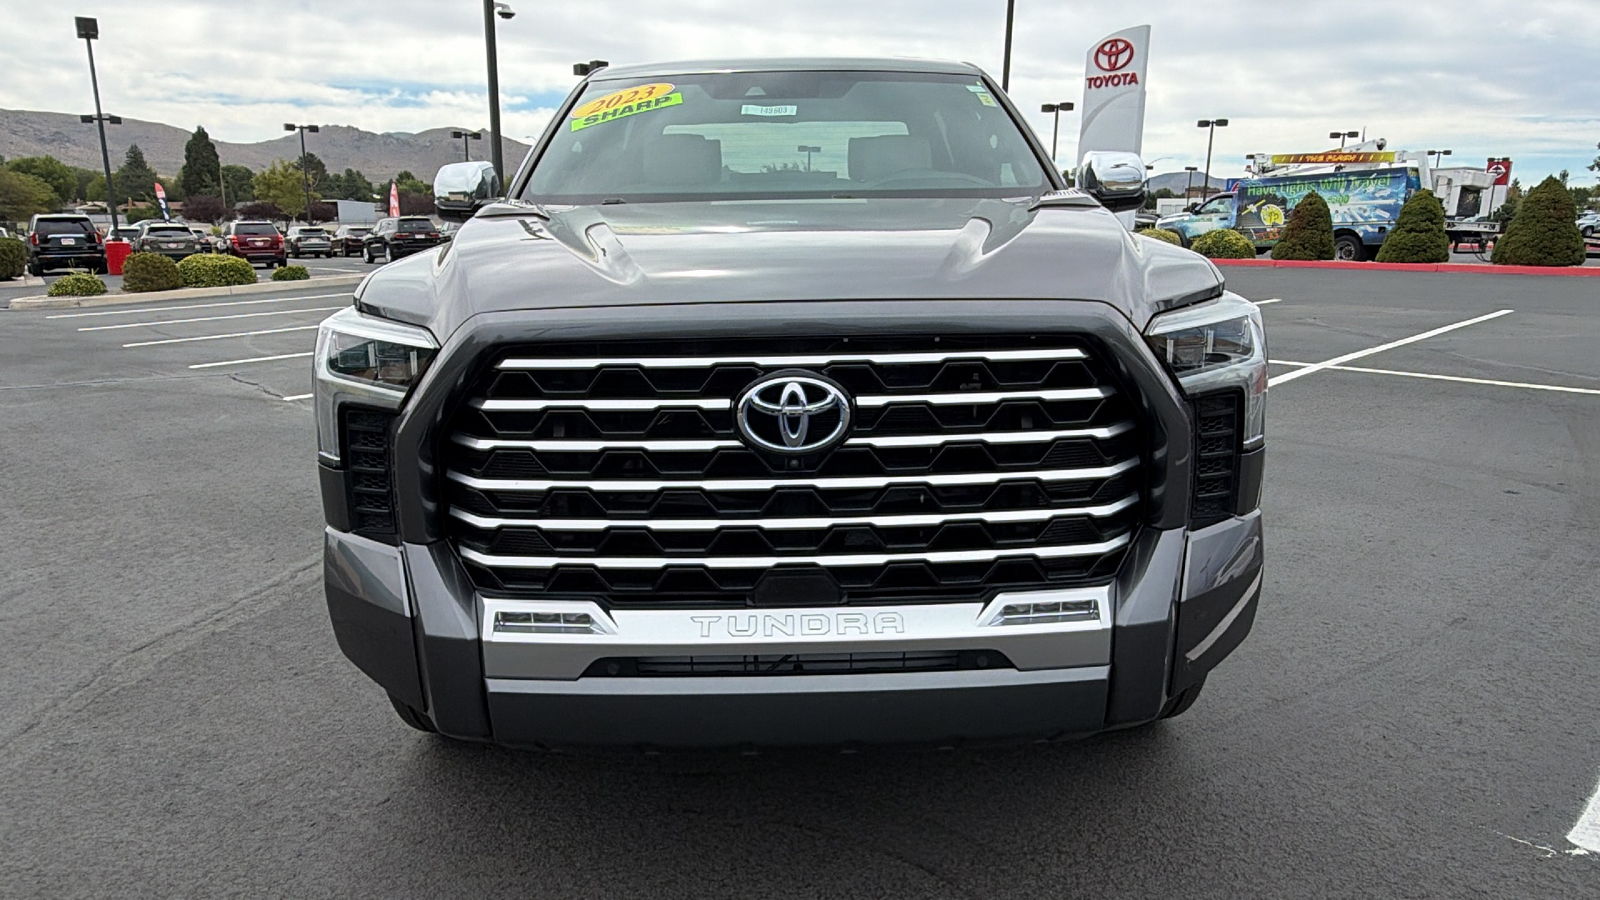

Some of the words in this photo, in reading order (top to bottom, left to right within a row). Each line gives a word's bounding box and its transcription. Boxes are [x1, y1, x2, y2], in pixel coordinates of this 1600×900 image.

[1086, 72, 1139, 89] TOYOTA
[583, 96, 672, 126] SHARP
[589, 86, 657, 114] 2023
[1247, 185, 1277, 196] Have
[1279, 180, 1315, 197] Lights
[1348, 173, 1391, 189] Travel
[690, 612, 906, 637] TUNDRA
